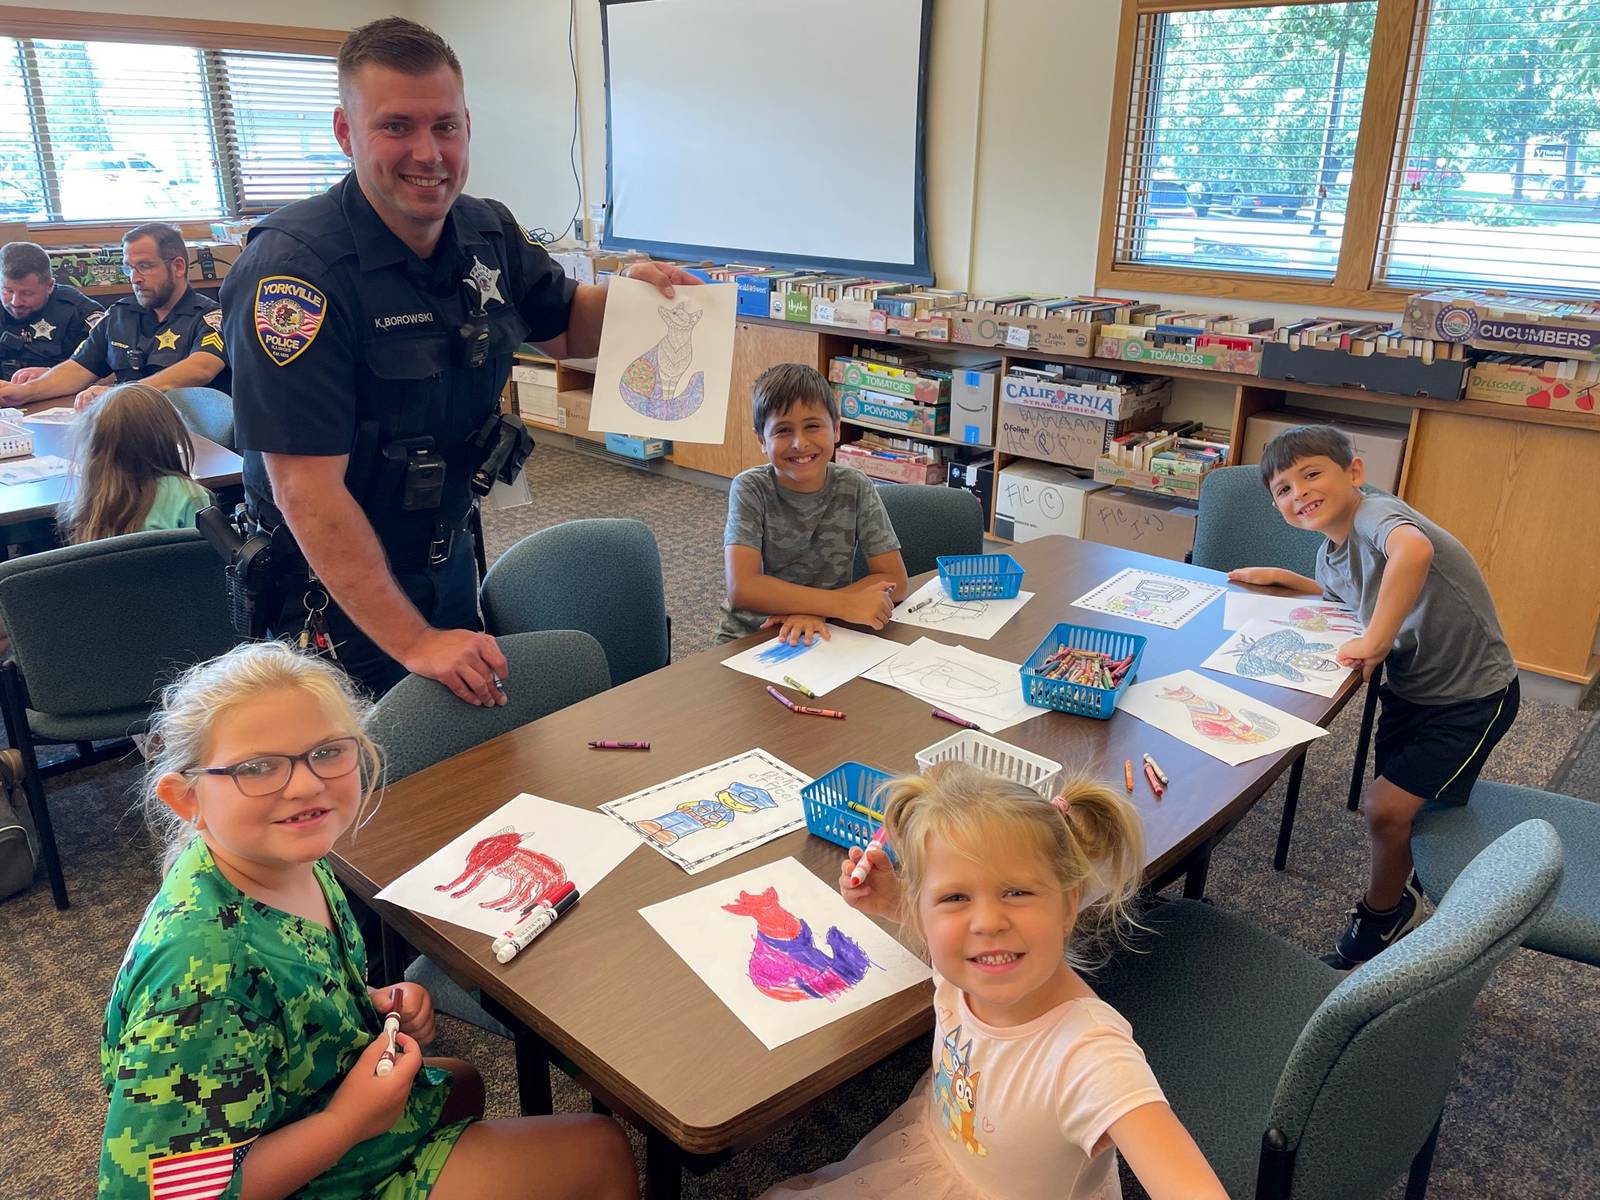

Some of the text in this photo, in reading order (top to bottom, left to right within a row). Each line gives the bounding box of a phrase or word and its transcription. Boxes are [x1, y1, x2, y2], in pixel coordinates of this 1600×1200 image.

[263, 283, 322, 308] YORKVILLE
[265, 334, 300, 350] POLICE
[1480, 324, 1591, 347] CUCUMBERS
[1150, 350, 1203, 364] TOMATOES
[866, 376, 911, 393] TOMATOES
[864, 405, 909, 422] POIVRONS
[1005, 483, 1034, 508] FIC
[1099, 506, 1128, 533] FIC
